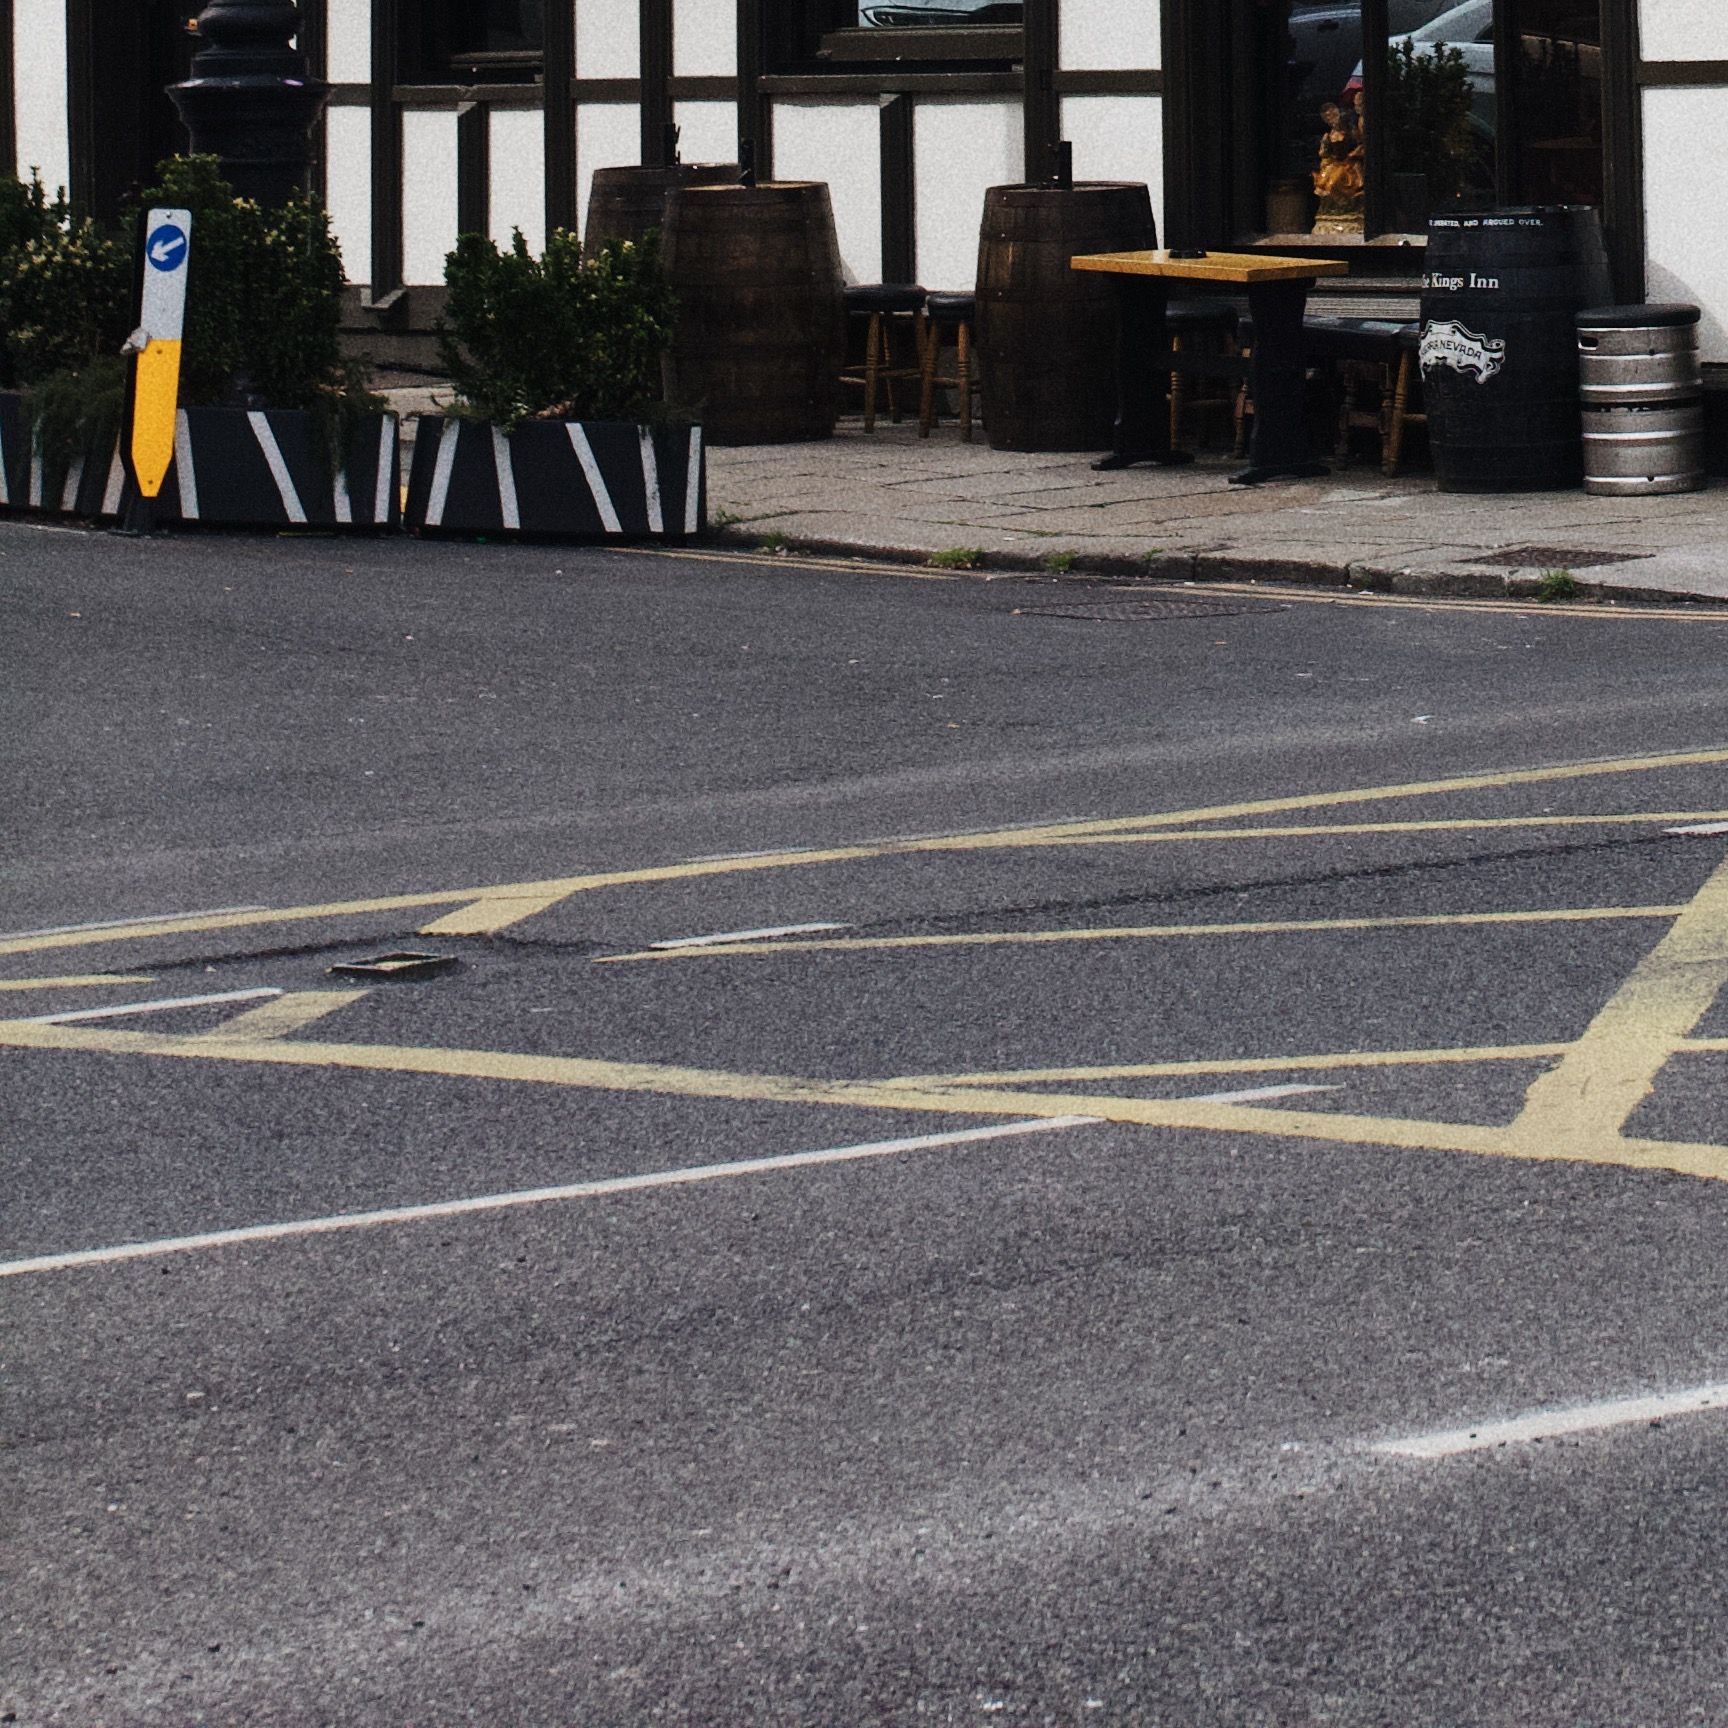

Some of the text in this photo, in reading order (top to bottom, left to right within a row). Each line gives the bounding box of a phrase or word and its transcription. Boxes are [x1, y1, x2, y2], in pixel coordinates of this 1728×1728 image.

[1431, 272, 1464, 291] Kings
[1469, 272, 1499, 289] Inn
[1440, 340, 1482, 361] NEVADA
